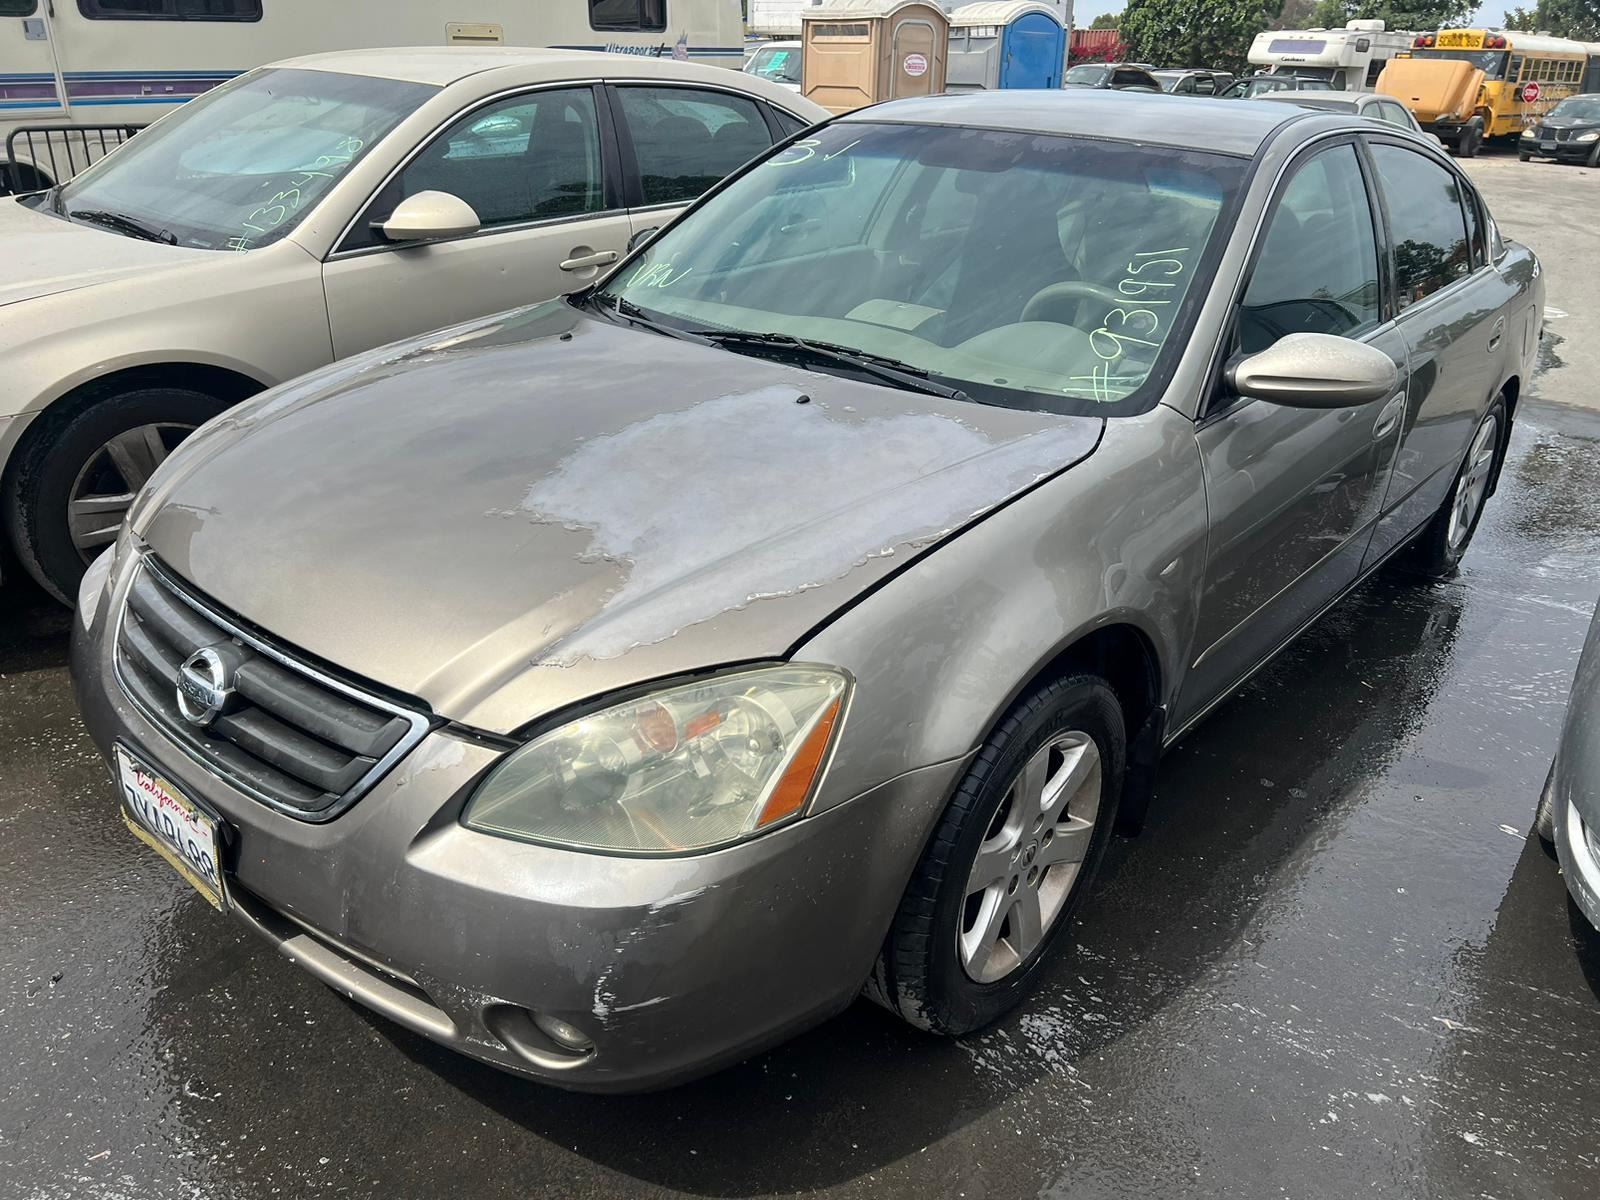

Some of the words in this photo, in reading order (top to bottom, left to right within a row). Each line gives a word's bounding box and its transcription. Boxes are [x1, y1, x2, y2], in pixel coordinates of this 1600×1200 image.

[1466, 36, 1480, 47] BUS
[1525, 88, 1538, 97] STOP
[1062, 247, 1190, 403] #931951
